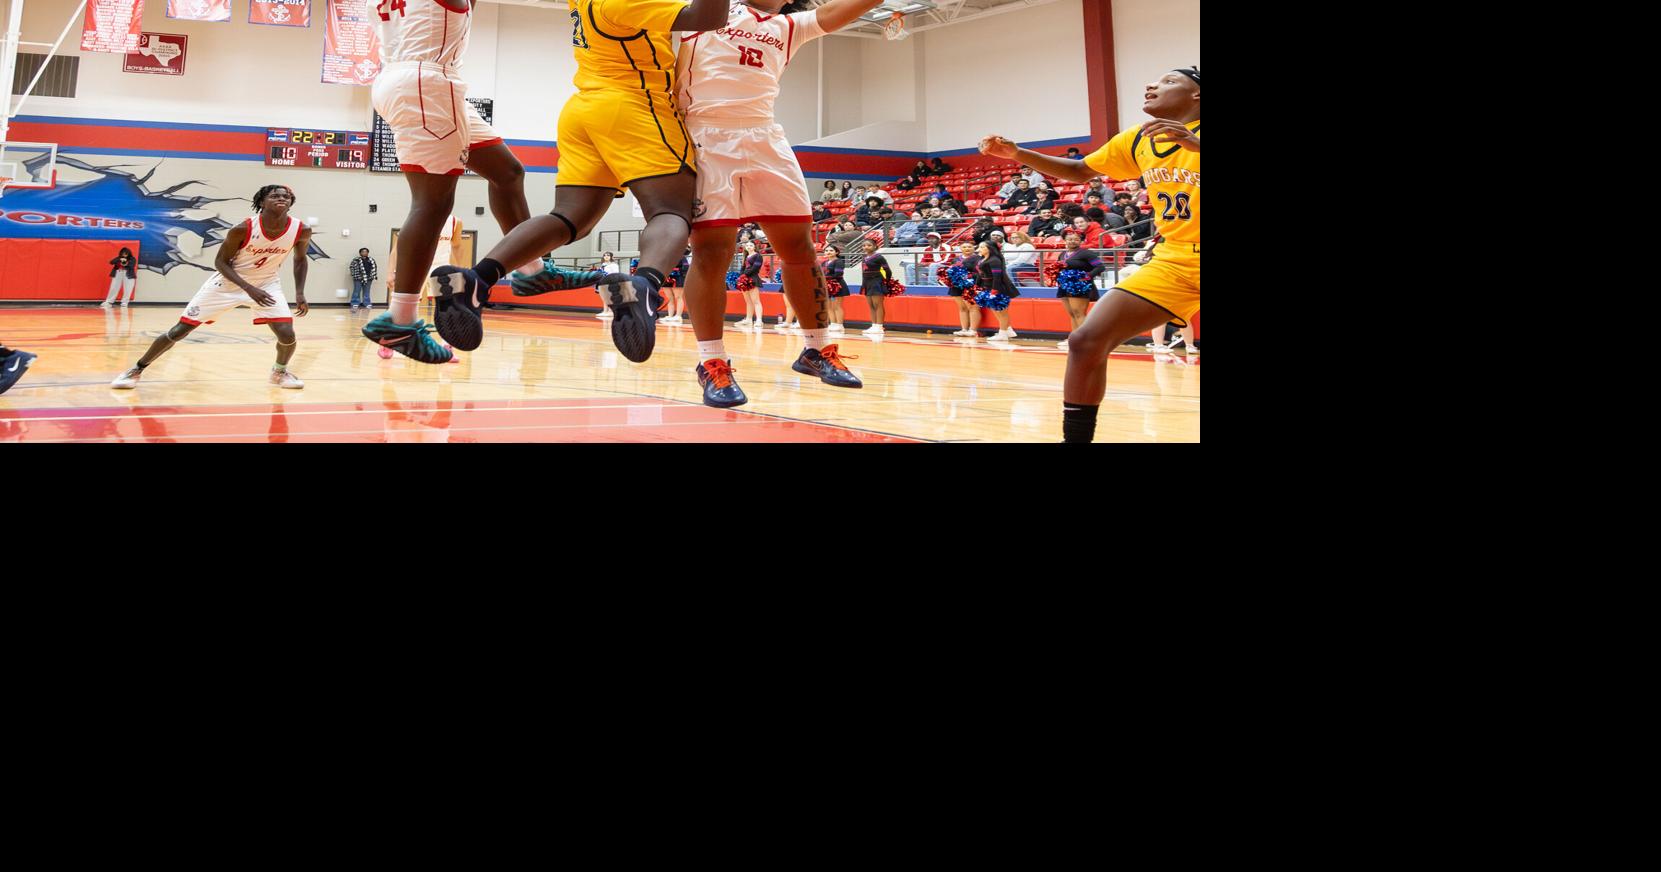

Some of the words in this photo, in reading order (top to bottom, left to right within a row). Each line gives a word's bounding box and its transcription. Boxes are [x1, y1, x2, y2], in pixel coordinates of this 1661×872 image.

[738, 45, 764, 68] 10
[282, 147, 296, 159] 10
[349, 150, 363, 161] 19
[272, 158, 296, 166] HOME
[336, 161, 366, 169] VISITOR
[1143, 167, 1200, 188] OUGARS
[1157, 191, 1192, 220] 20
[0, 208, 145, 229] ORTERS
[254, 256, 268, 269] 4
